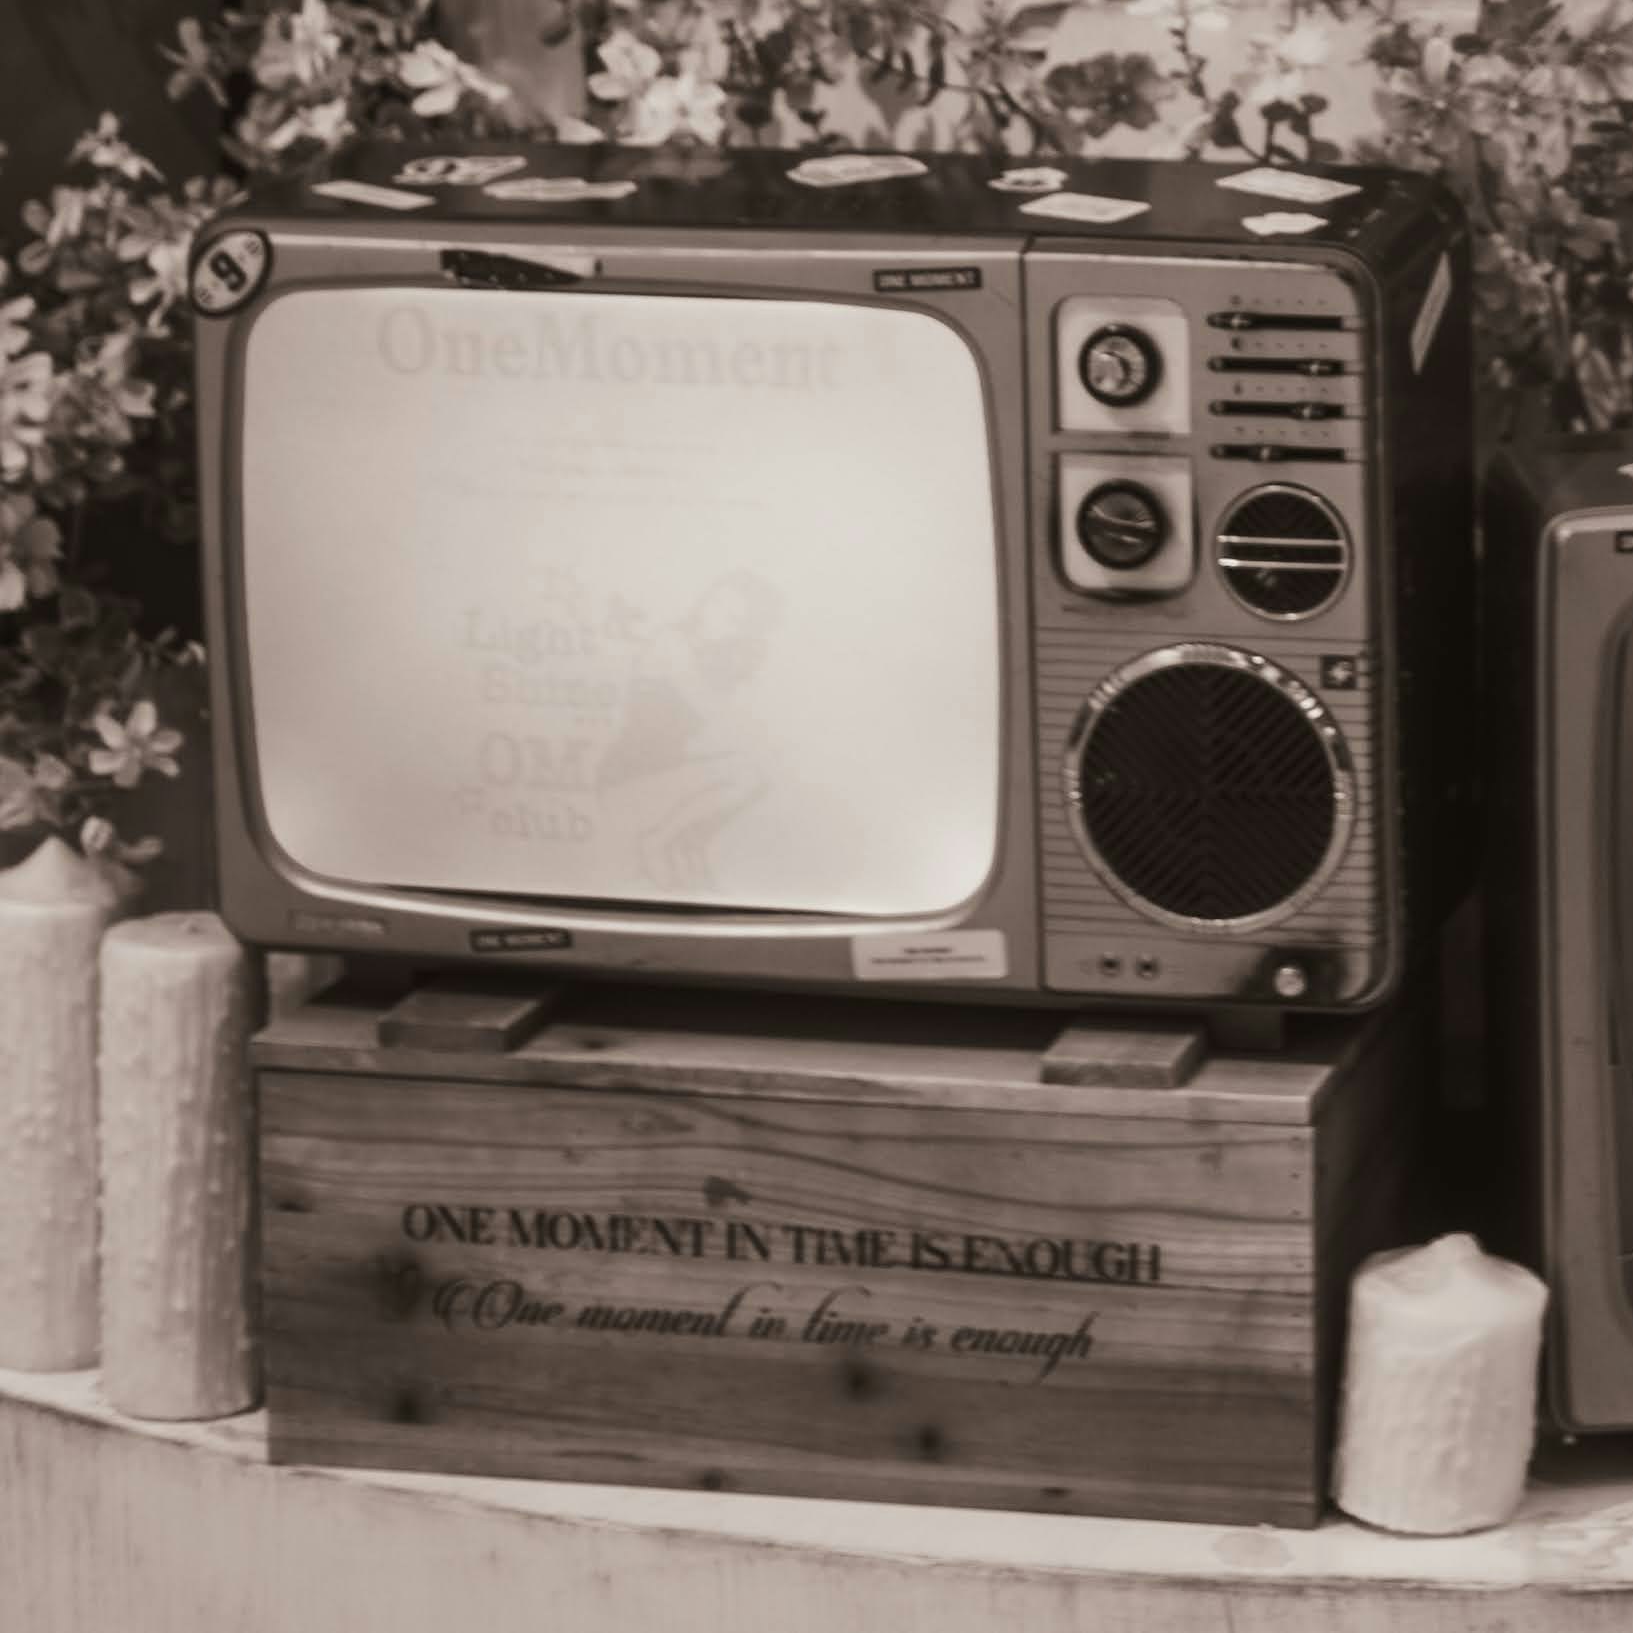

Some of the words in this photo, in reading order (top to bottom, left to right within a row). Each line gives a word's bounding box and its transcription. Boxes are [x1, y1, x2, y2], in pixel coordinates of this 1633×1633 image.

[377, 304, 846, 390] OneMoment
[402, 1204, 496, 1245] ONE
[509, 1208, 713, 1258] MOMENT
[726, 1221, 771, 1262] IN
[781, 1225, 896, 1267] TIME
[911, 1231, 952, 1270] IS
[962, 1235, 1162, 1282] ENOUGH
[433, 1279, 565, 1331] One
[577, 1281, 783, 1337] moment
[747, 1307, 788, 1338] in
[801, 1285, 890, 1344] time
[904, 1316, 938, 1350] is
[949, 1311, 1099, 1386] enough
